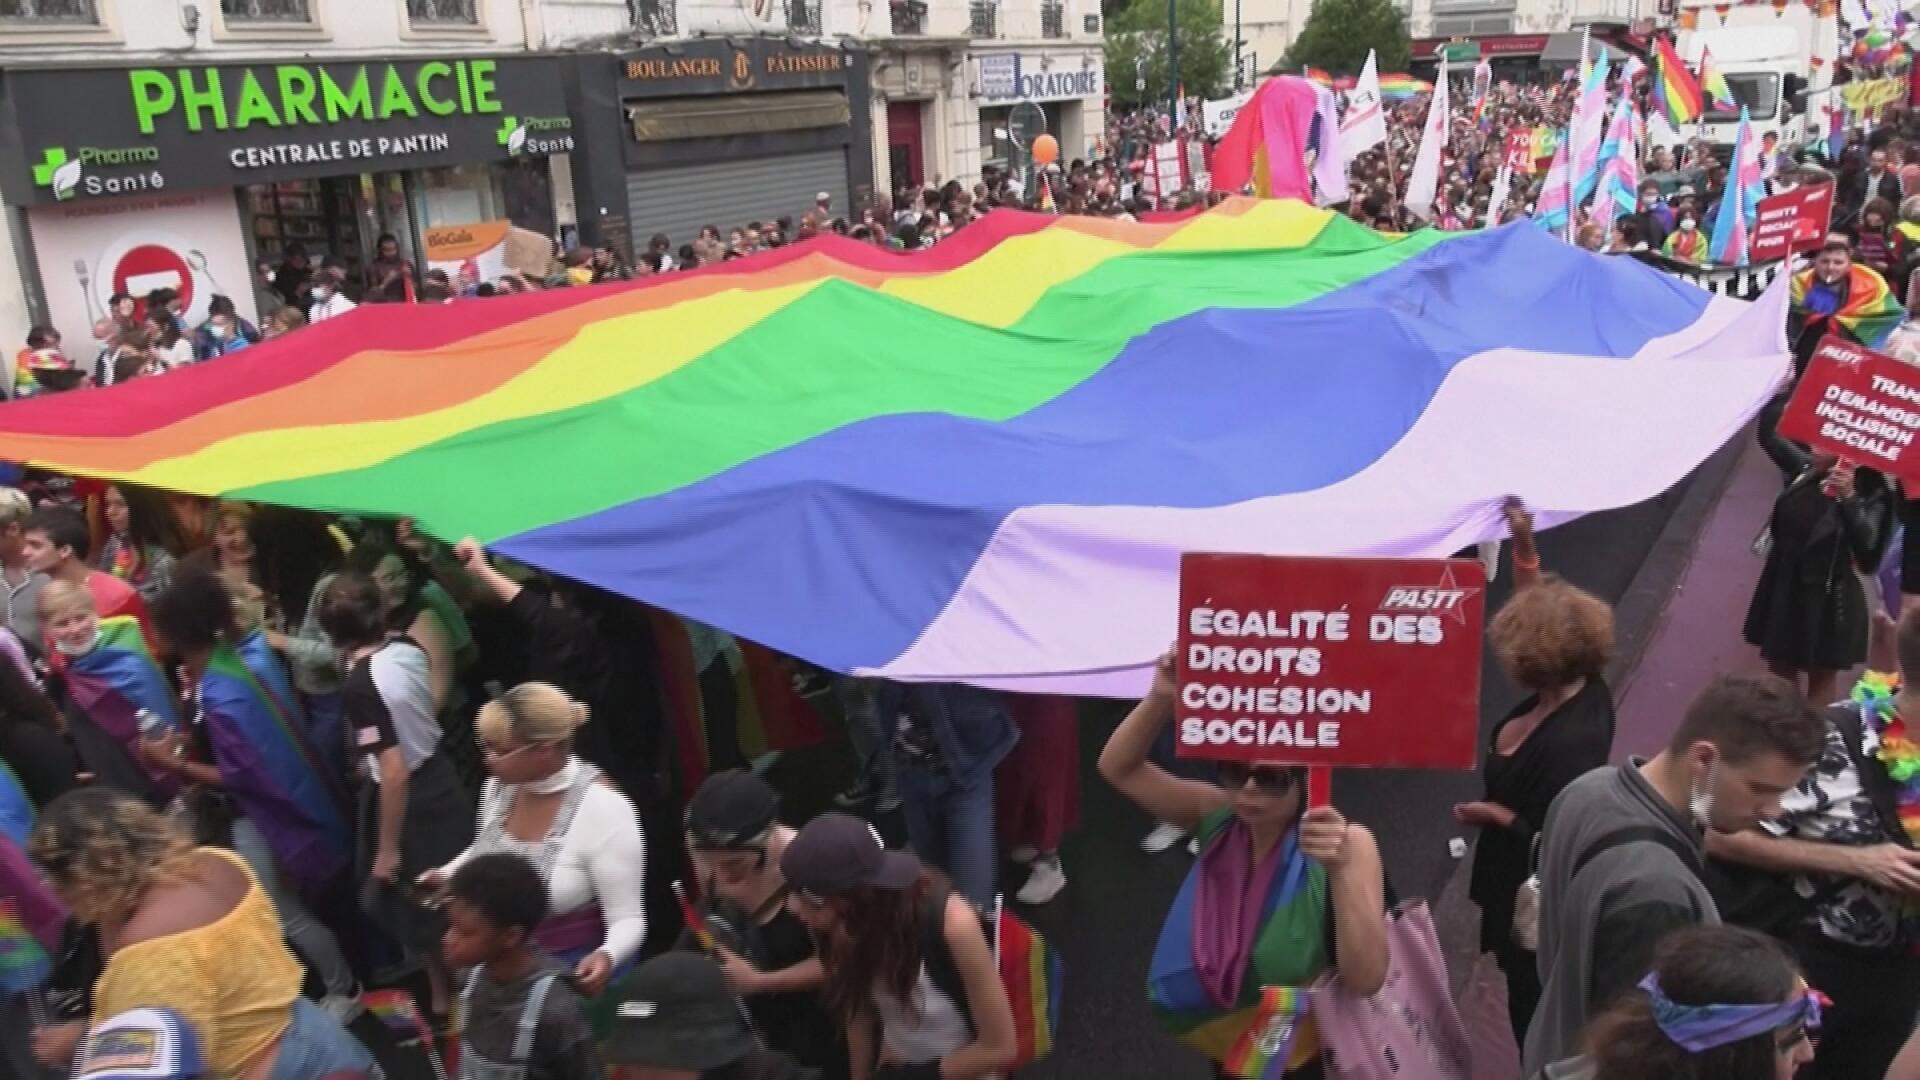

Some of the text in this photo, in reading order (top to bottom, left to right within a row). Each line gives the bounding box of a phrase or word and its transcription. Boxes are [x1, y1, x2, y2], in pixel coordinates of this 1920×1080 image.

[627, 58, 721, 79] BOULANGER
[1022, 71, 1097, 98] ORATOIRE
[129, 61, 502, 133] PHARMACIE
[523, 116, 572, 131] Pharma
[79, 145, 160, 165] Pharma
[231, 133, 449, 169] CENTRALE DE PANTIN
[85, 171, 164, 195] Santé
[1872, 375, 1920, 405] TRAN
[1825, 385, 1920, 430] DEMANDE
[1815, 402, 1915, 446] INCLUSION
[1820, 422, 1902, 461] SOCIALE
[1383, 589, 1465, 609] PASTT
[1189, 597, 1444, 645] ÉGALITÉ DES
[1188, 643, 1321, 676] DROITS
[1182, 677, 1371, 714] COHÉSION
[1180, 717, 1341, 748] SOCIALE
